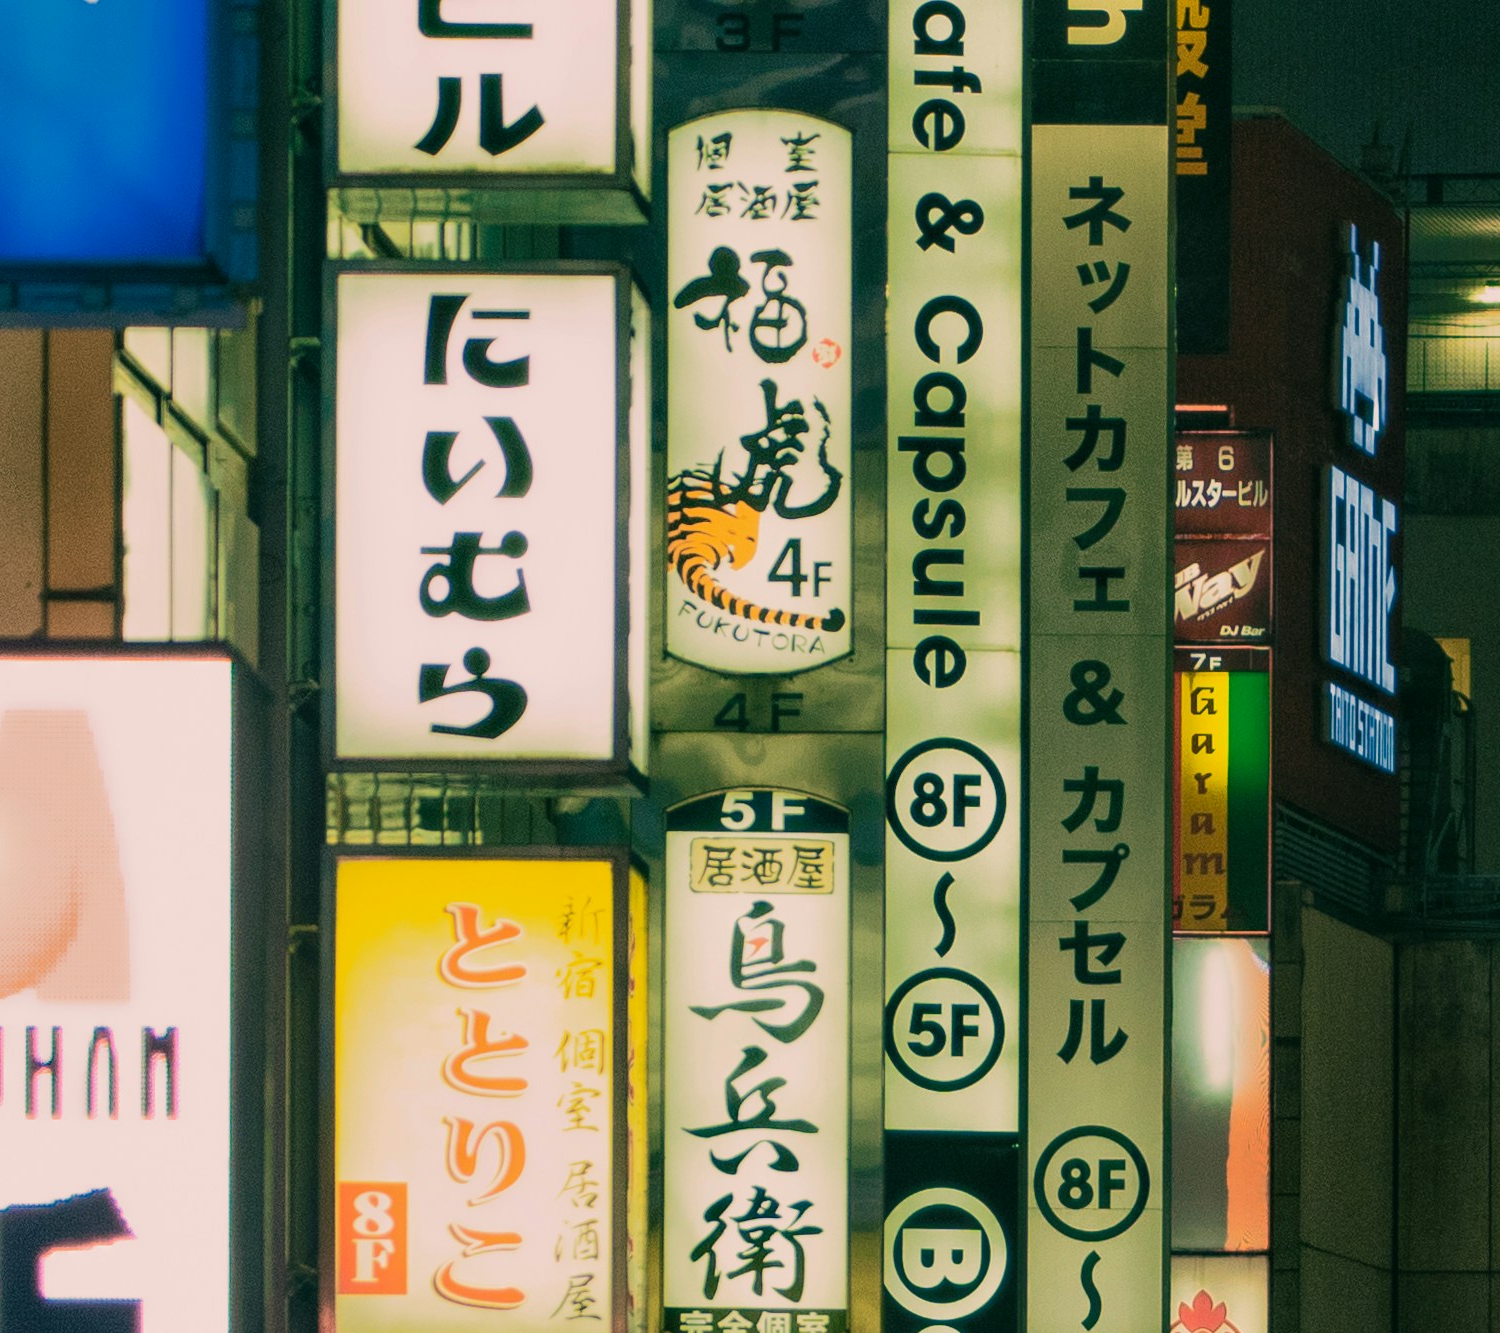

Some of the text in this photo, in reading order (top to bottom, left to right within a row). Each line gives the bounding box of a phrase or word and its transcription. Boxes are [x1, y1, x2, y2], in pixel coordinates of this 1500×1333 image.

[695, 180, 821, 220] 居酒屋
[419, 293, 534, 739] にいむら
[897, 294, 984, 689] Capsule
[677, 600, 828, 656] FUKUTORA
[767, 537, 833, 598] 4F
[1056, 176, 1132, 1066] ネットカフェ カプセル
[1241, 625, 1266, 637] Bar
[1330, 464, 1397, 694] GAME
[1190, 653, 1222, 671] 7F
[720, 791, 806, 831] 5F
[1184, 686, 1227, 877] Garam
[698, 845, 828, 888] 居酒屋
[434, 901, 530, 1311] ととりこ
[552, 896, 606, 1322] 新宿 個室 居酒屋
[680, 899, 825, 1304] 鳥兵衛
[351, 1191, 395, 1284] 8F
